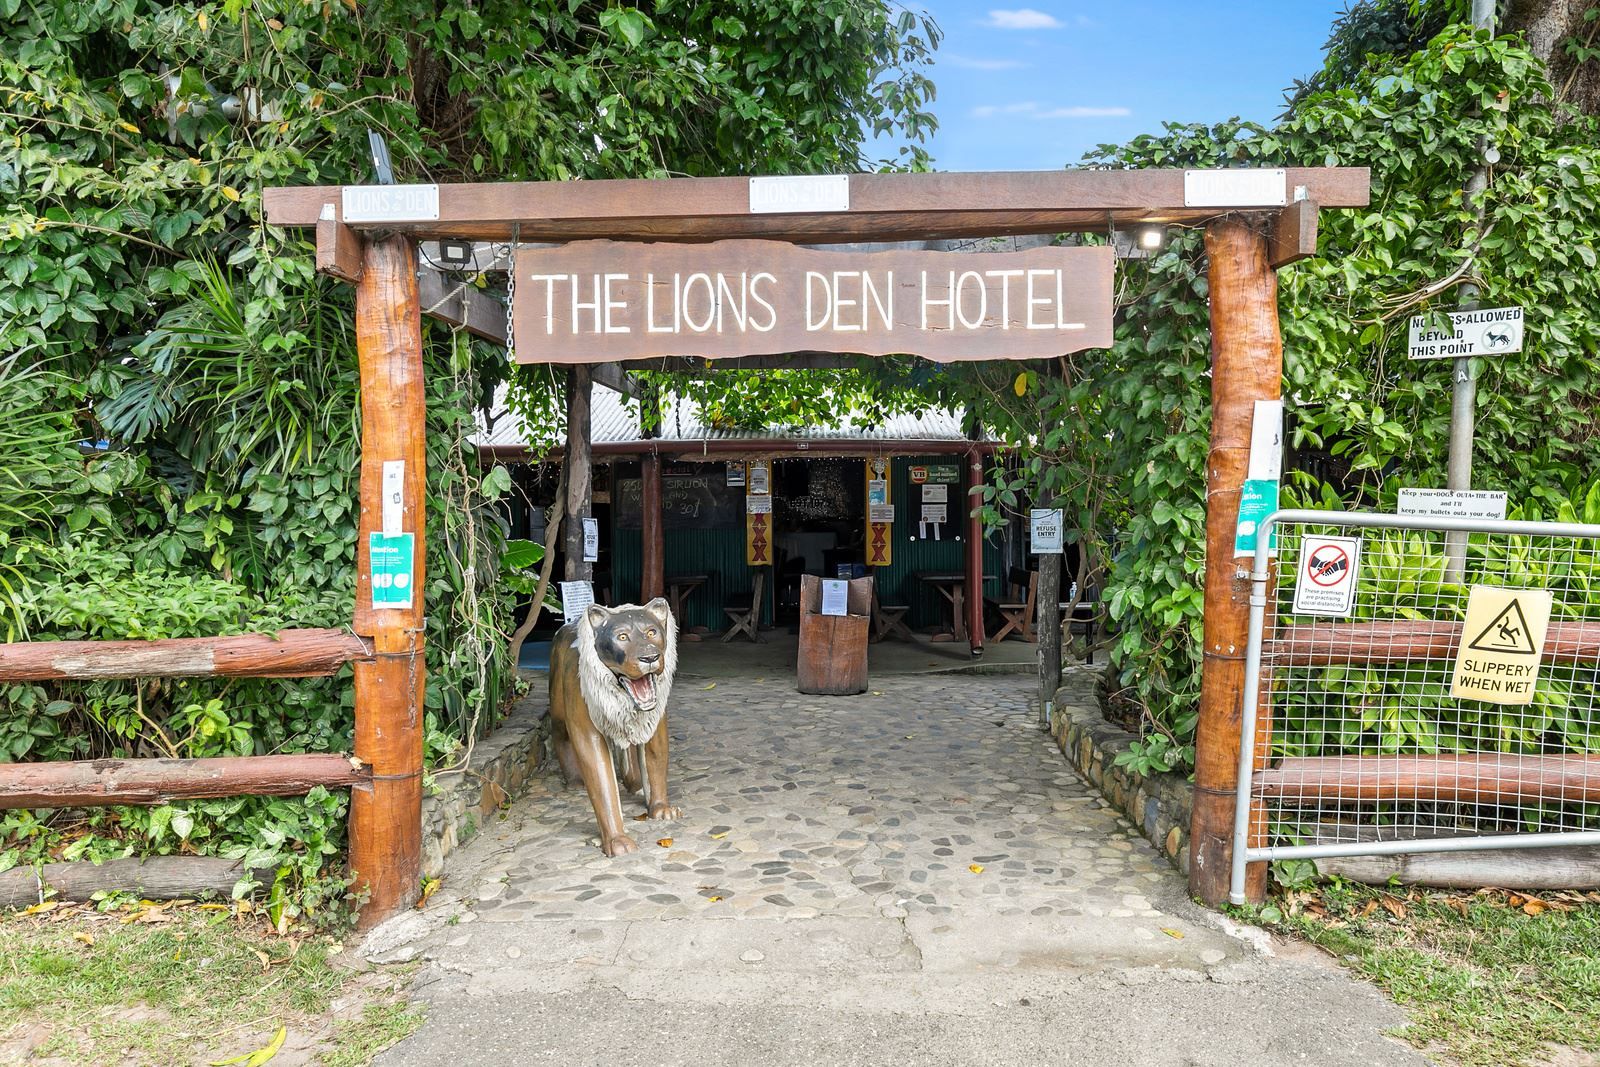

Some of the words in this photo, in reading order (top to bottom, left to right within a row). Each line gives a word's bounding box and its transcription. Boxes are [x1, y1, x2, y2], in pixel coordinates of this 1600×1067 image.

[348, 191, 390, 213] LIONS
[406, 190, 433, 211] DEN
[755, 182, 798, 203] LIONS
[815, 181, 843, 202] DEN
[532, 274, 630, 334] THE
[648, 272, 777, 333] LIONS
[806, 271, 893, 331] DEN
[922, 269, 1085, 331] HOTEL
[1466, 309, 1521, 324] ALLOWED
[1410, 345, 1436, 357] THIS
[1440, 343, 1475, 355] POINT
[1463, 659, 1533, 677] SLIPPERY
[1459, 675, 1501, 692] WHEN
[1505, 681, 1531, 694] WET
